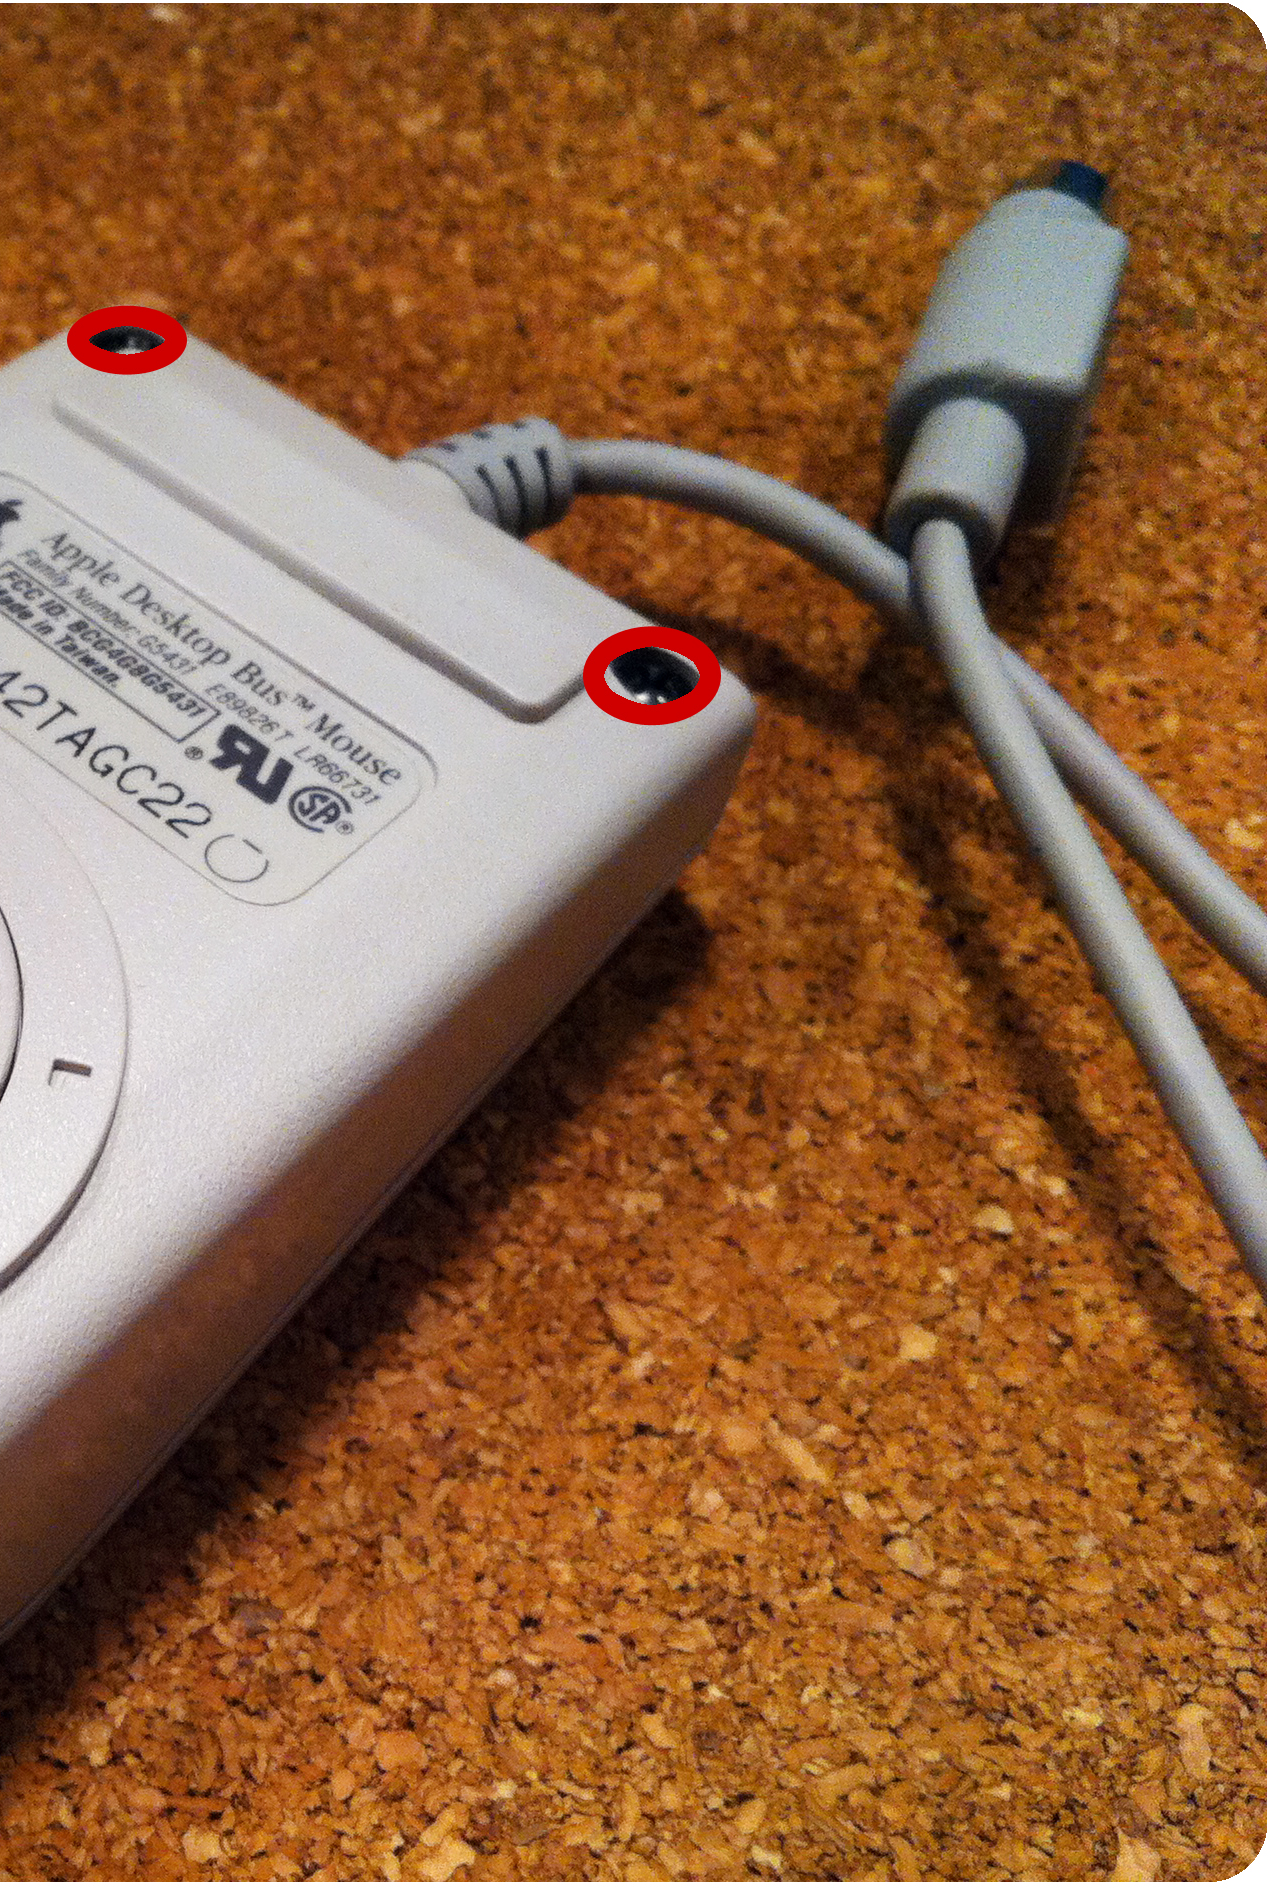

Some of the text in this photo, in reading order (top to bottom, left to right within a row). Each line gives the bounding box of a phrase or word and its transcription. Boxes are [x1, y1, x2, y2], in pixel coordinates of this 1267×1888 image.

[16, 549, 71, 588] Family
[70, 586, 141, 637] Number:
[137, 634, 198, 675] G5431
[31, 619, 55, 636] in
[53, 633, 121, 689] Taiwan.
[41, 532, 120, 587] Apple
[119, 582, 232, 666] Desktop
[304, 712, 402, 786] Mouse
